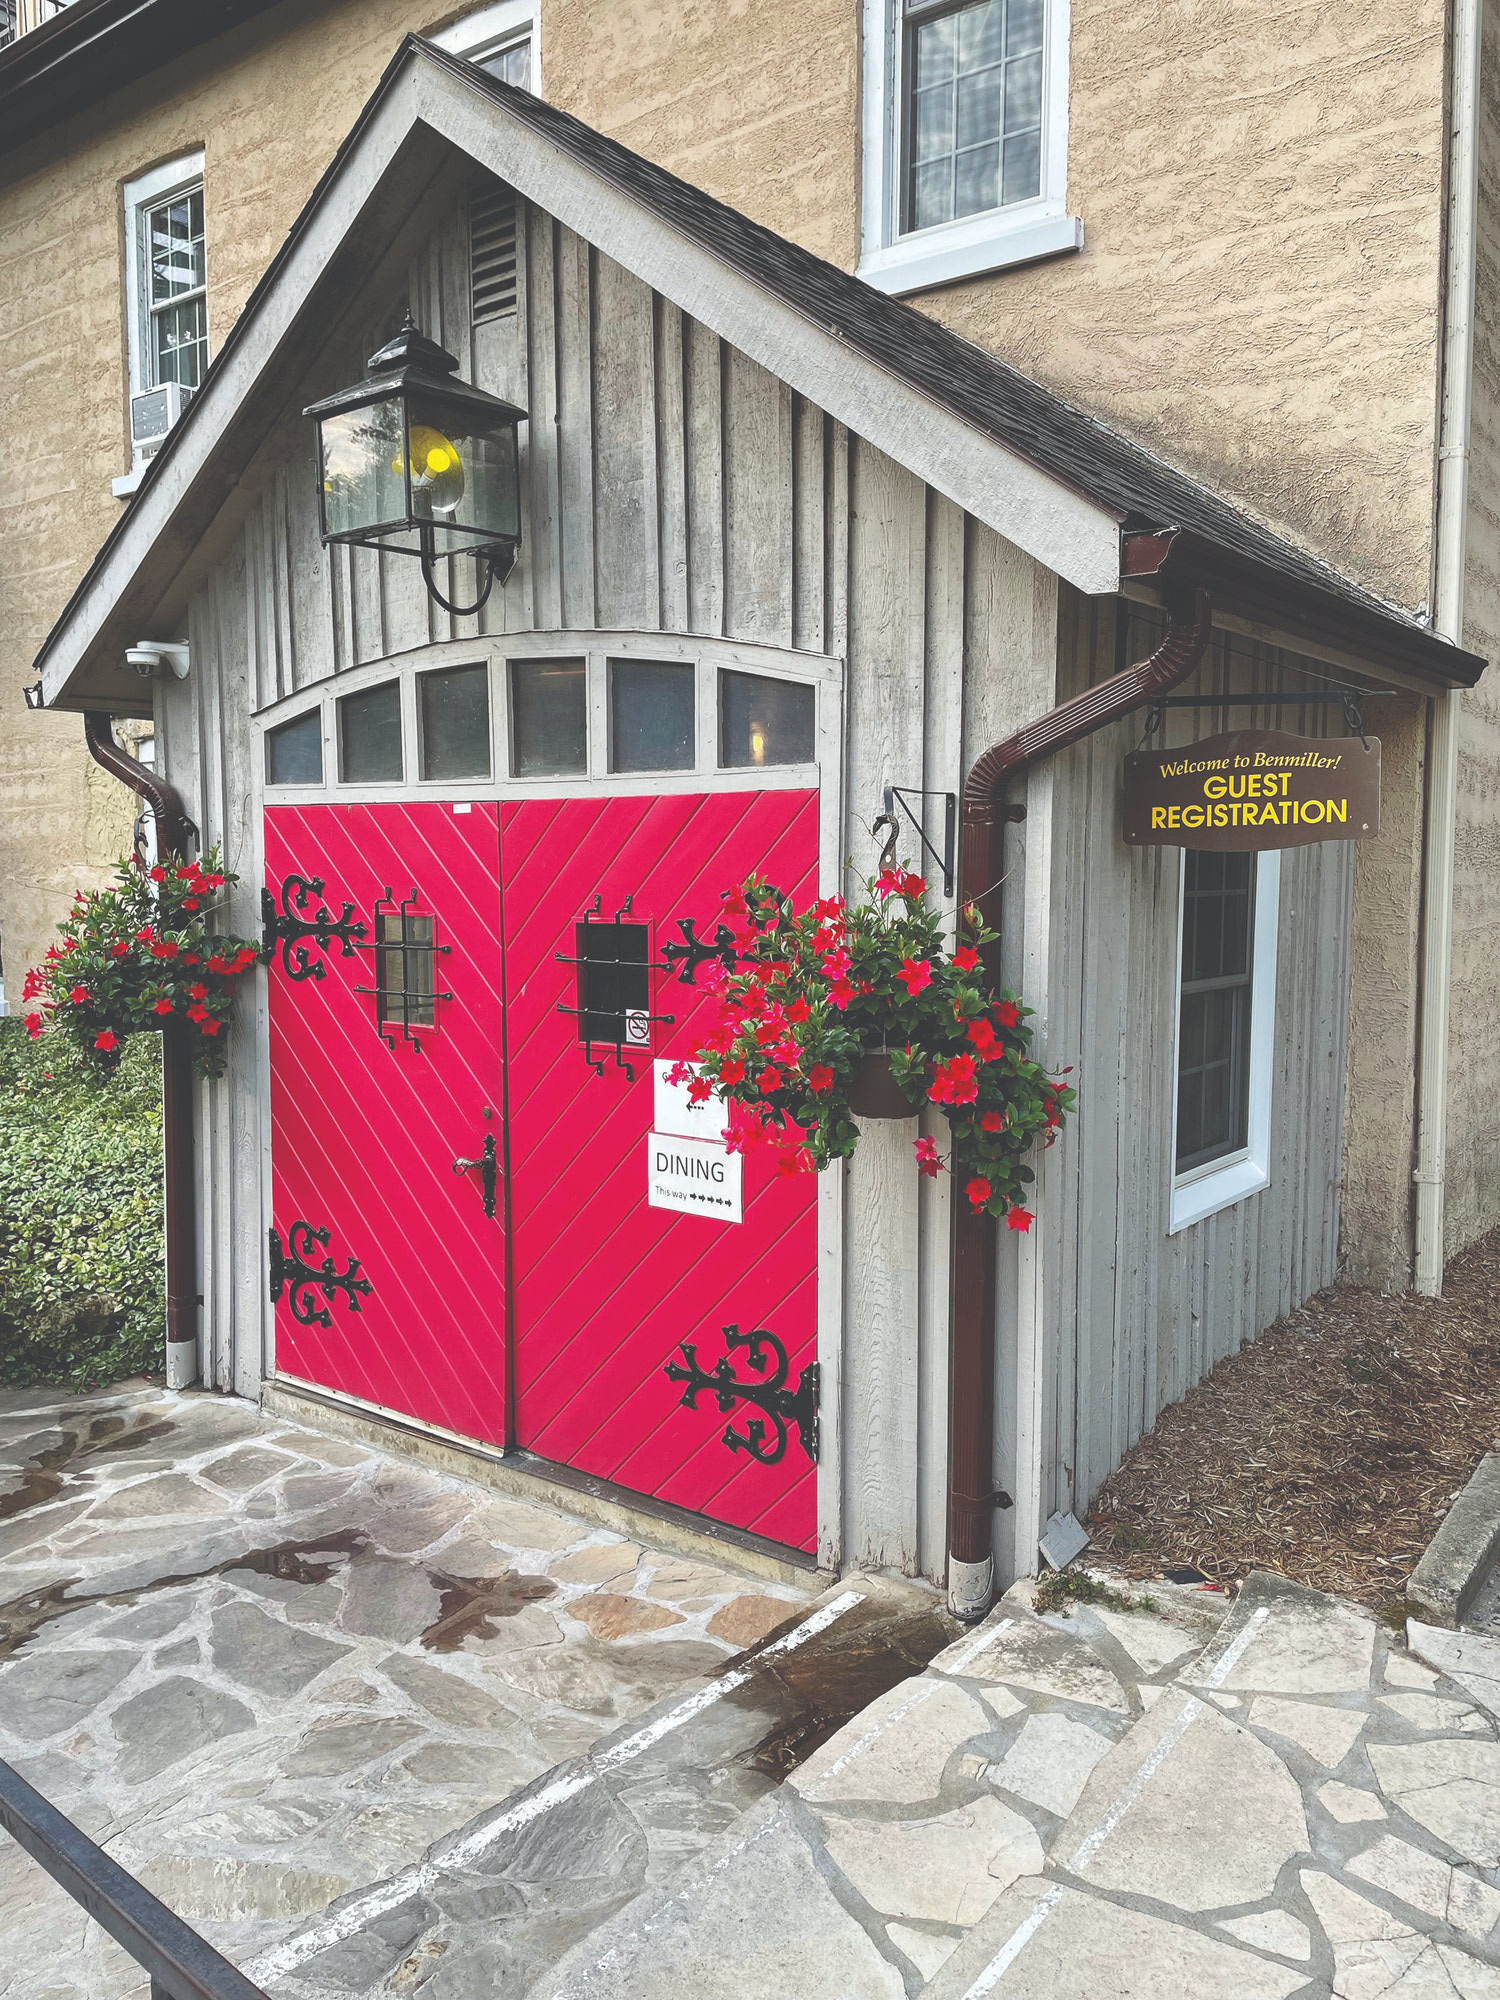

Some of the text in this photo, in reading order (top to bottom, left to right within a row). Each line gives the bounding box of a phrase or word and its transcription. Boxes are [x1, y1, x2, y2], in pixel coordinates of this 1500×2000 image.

[1160, 752, 1342, 778] Welcome to Benmiller!
[1203, 773, 1292, 799] GUEST
[1151, 799, 1347, 829] REGISTRATION
[656, 1152, 725, 1183] DINING
[655, 1185, 688, 1201] This way
